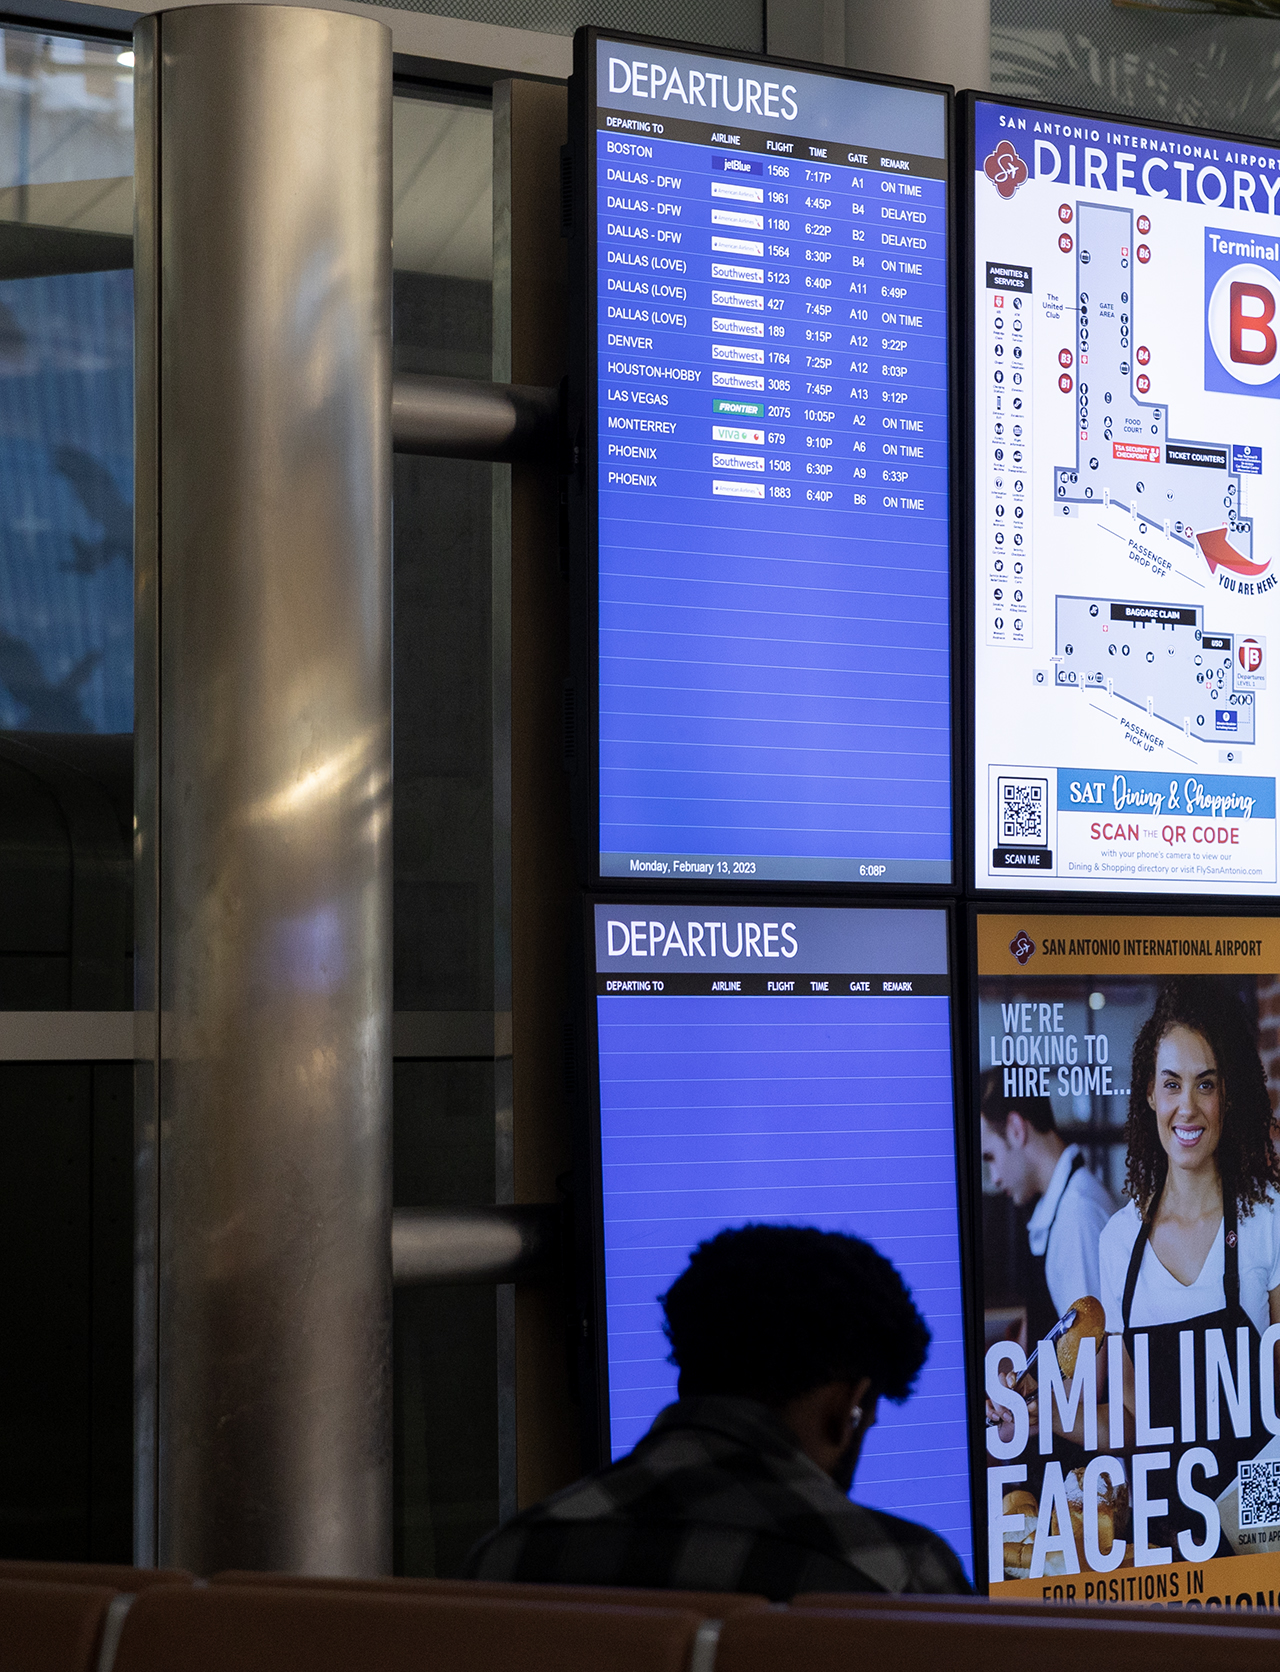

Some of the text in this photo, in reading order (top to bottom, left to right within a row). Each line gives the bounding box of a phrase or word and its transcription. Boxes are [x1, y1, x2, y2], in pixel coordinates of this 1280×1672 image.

[608, 57, 798, 120] DEPARTURES
[607, 116, 910, 171] DEPARTING TO AIRLINE FLIGHT TIME GATE REMARK
[1000, 115, 1026, 130] SAN
[1034, 121, 1100, 141] ANTONIO
[1107, 132, 1220, 161] INTERNATIONAL
[607, 141, 922, 197] BOSTON jetBlue 1566 7:17P A1 ON TIME
[1209, 234, 1279, 262] Terminal
[608, 251, 907, 300] DALLAS (LOVE) Southwest 5123 6:40P A11 6:49P
[990, 268, 1022, 279] AMENITIES
[994, 277, 1024, 287] SERVICES
[1043, 302, 1063, 310] United
[1046, 311, 1060, 319] Club
[1230, 281, 1277, 366] B
[608, 361, 908, 404] HOUSTON-HOBBY Southwest 3085 7:45P A13 9:12P
[608, 389, 924, 433] LAS VEGAS FRONTIER 2075 10:05P A2 ON TIME
[1124, 426, 1142, 434] COURT
[1115, 444, 1149, 454] TSA SECURITY
[1116, 451, 1148, 459] CHECKPOINT
[1169, 451, 1190, 460] TICKET
[1192, 453, 1225, 464] COUNTERS
[1128, 539, 1172, 571] PASSENGER
[1128, 551, 1166, 577] DROP OFF
[1218, 573, 1278, 595] YOU ARE HERE
[1126, 608, 1180, 619] BAGGAGE CLAIM
[1120, 717, 1164, 748] PASSENGER
[1124, 732, 1154, 753] PICK UP
[1070, 775, 1256, 818] SAT Dining & Shopping
[1090, 823, 1239, 846] SCAN THE QR CODE
[630, 860, 886, 877] Monday, February 13, 2023 6:08P
[1005, 854, 1040, 864] SCAN ME
[607, 921, 798, 958] DEPARTURES
[1043, 939, 1262, 956] SAN ANTONIO INTERNATIONAL AIRPORT
[606, 981, 912, 992] DEPARTING TO AIRLINE FLIGHT TIME GATE REMARK
[991, 1035, 1109, 1066] LOOKING TO
[1004, 1066, 1131, 1097] HIRE SOME...
[987, 1446, 1220, 1584] FACES
[1238, 1533, 1256, 1545] SCAN
[1258, 1533, 1266, 1544] TO
[1084, 1572, 1179, 1604] POSITIONS
[1187, 1570, 1204, 1594] IN
